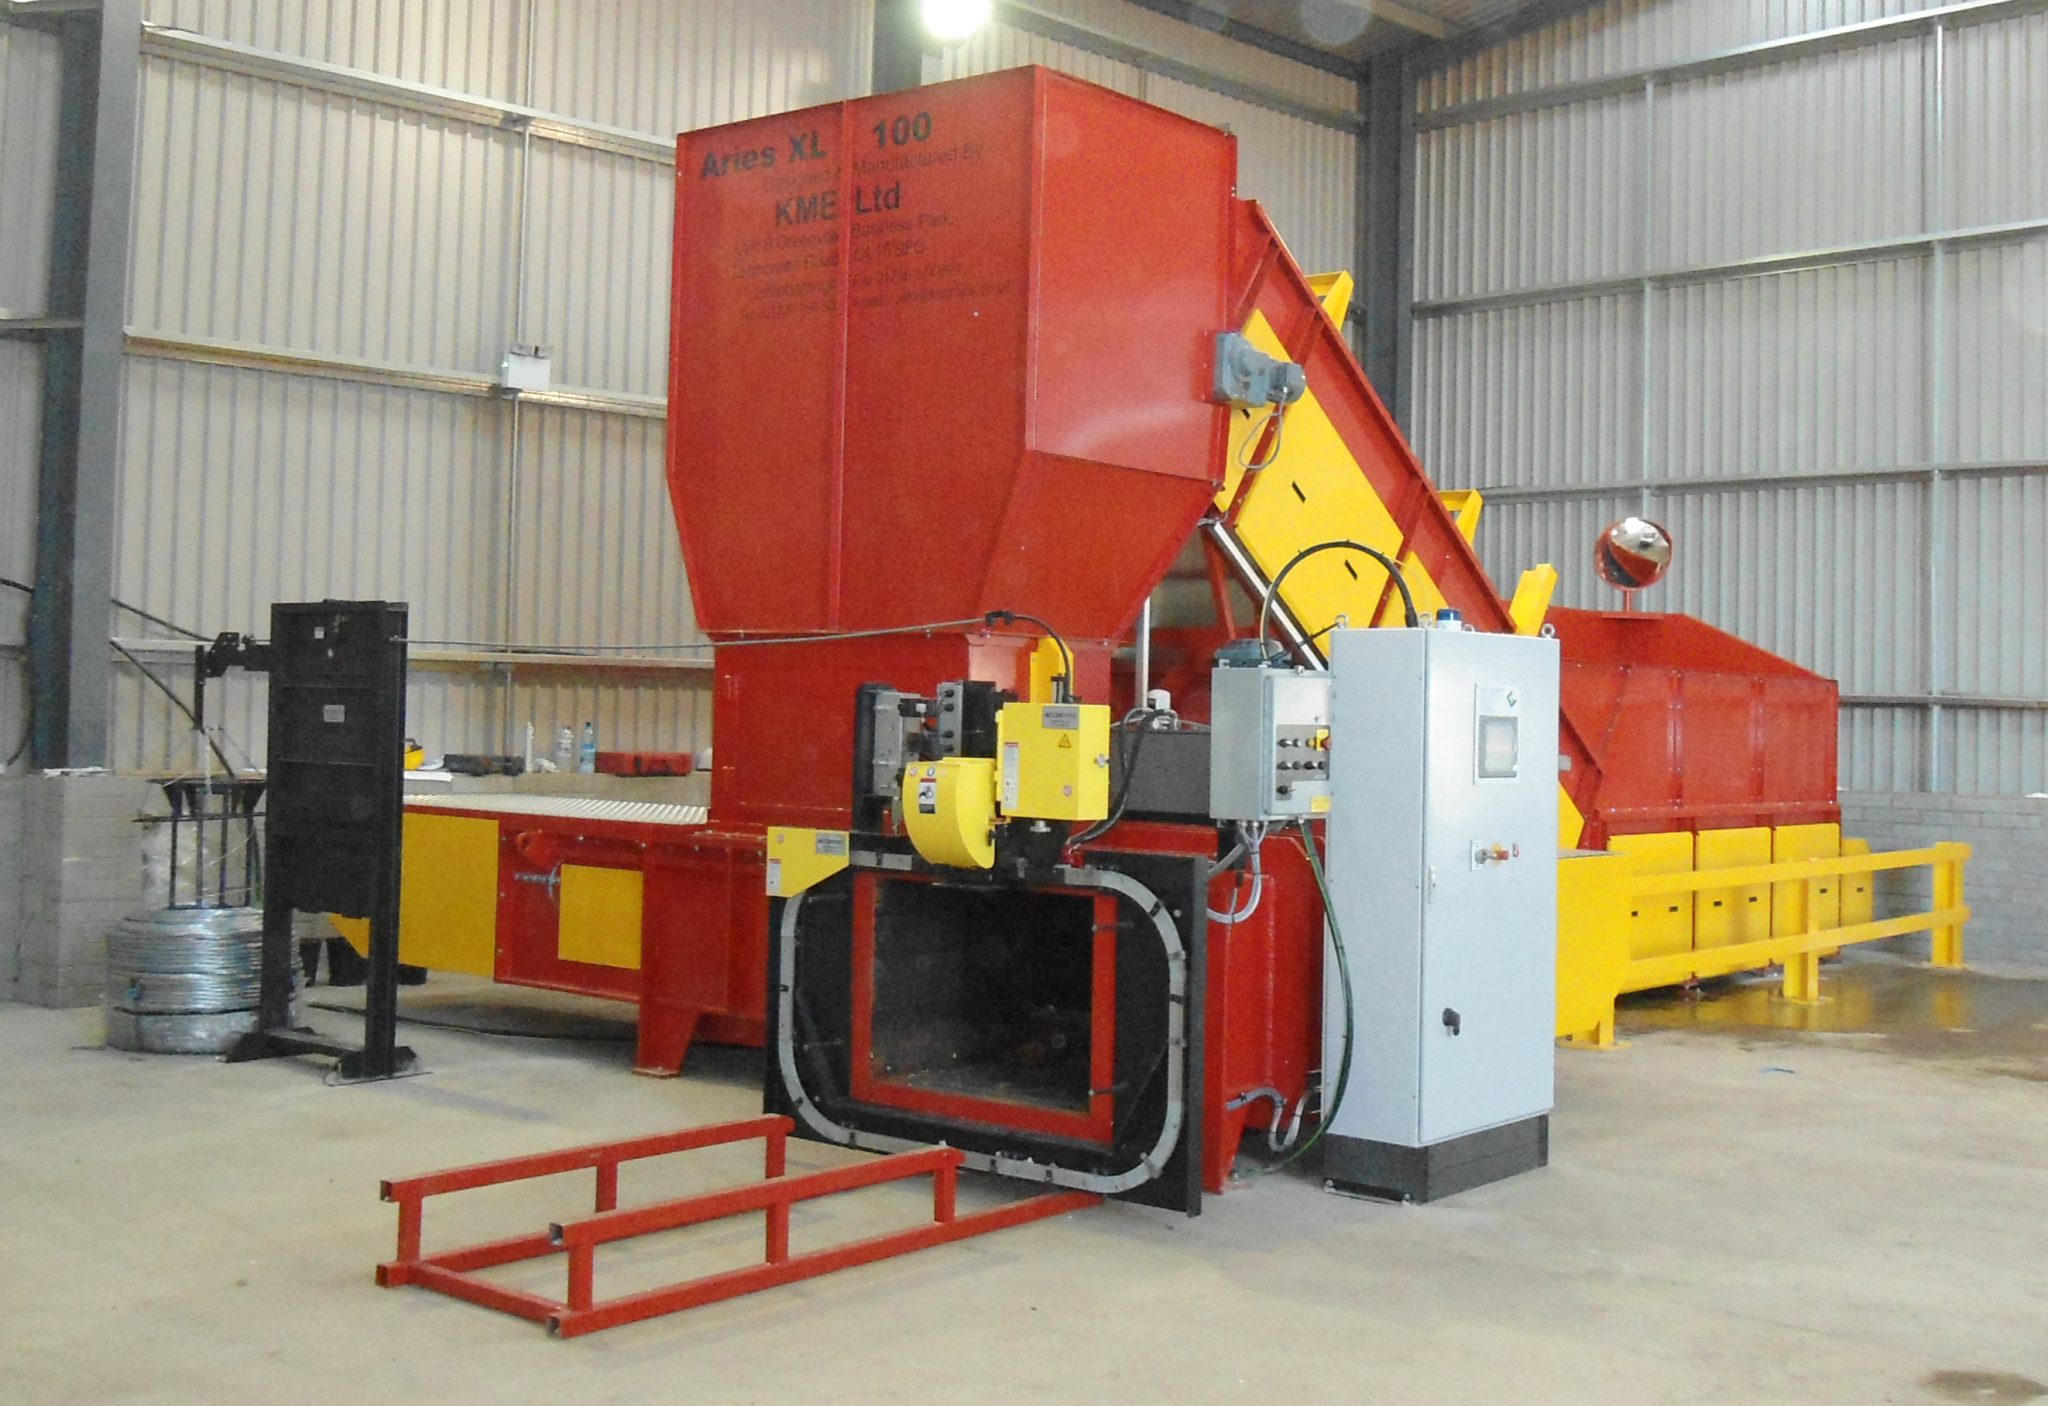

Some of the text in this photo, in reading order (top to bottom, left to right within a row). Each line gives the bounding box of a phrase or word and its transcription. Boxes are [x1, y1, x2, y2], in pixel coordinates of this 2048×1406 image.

[700, 110, 933, 179] Aries XL 100
[963, 141, 984, 161] By
[775, 180, 902, 228] KME Ltd
